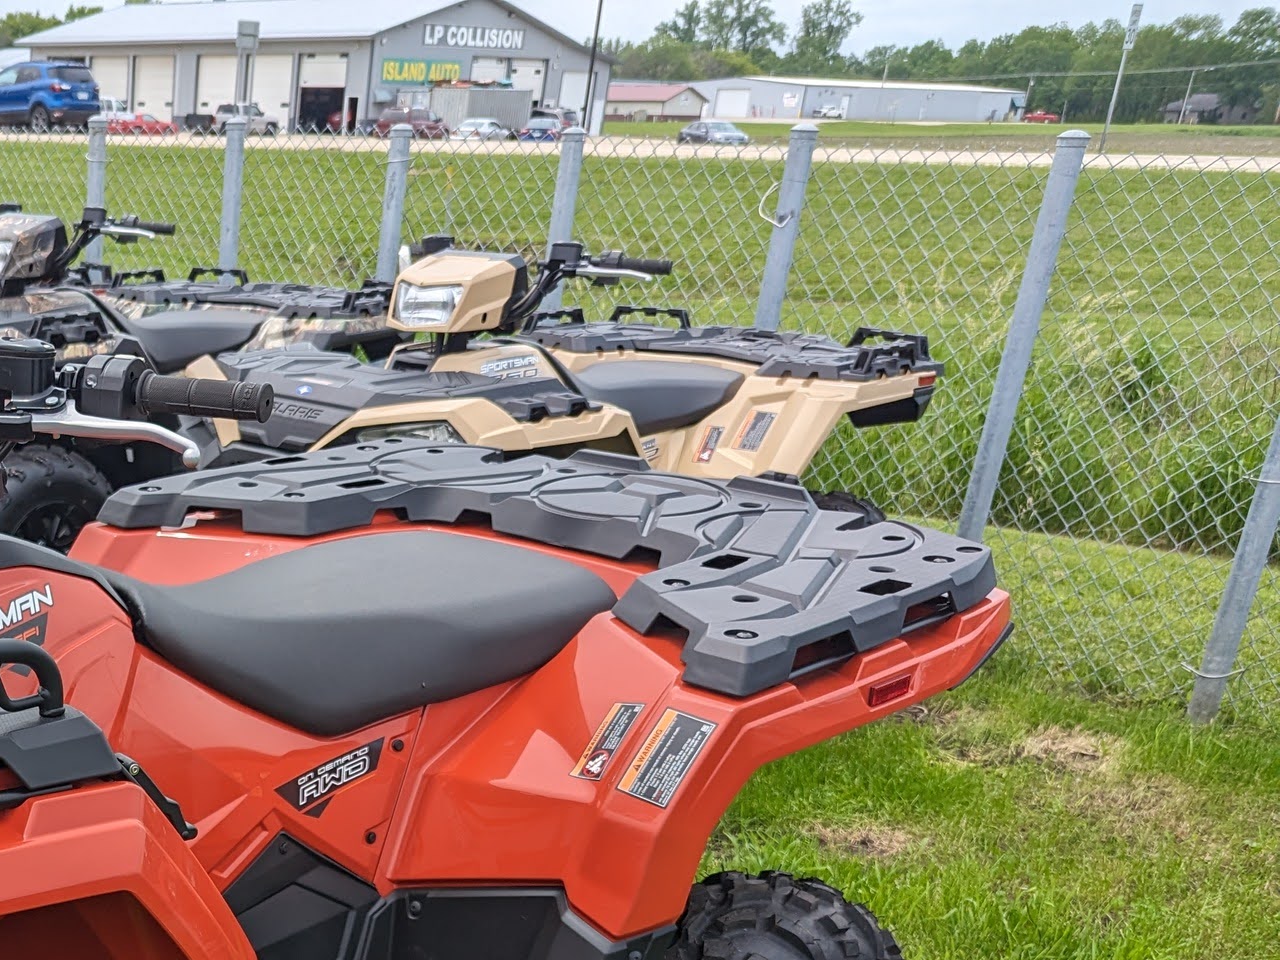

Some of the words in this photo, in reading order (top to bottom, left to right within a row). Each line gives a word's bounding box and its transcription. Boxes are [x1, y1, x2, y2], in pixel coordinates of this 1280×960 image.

[425, 24, 444, 45] LP
[447, 26, 525, 49] COLLISION
[382, 61, 426, 81] ISLAND
[428, 63, 461, 81] AUTO
[480, 356, 538, 374] SPORTSMAN
[637, 729, 663, 763] WARNING
[298, 772, 314, 785] ON
[318, 746, 370, 775] DEMAND
[299, 756, 370, 806] AWD
